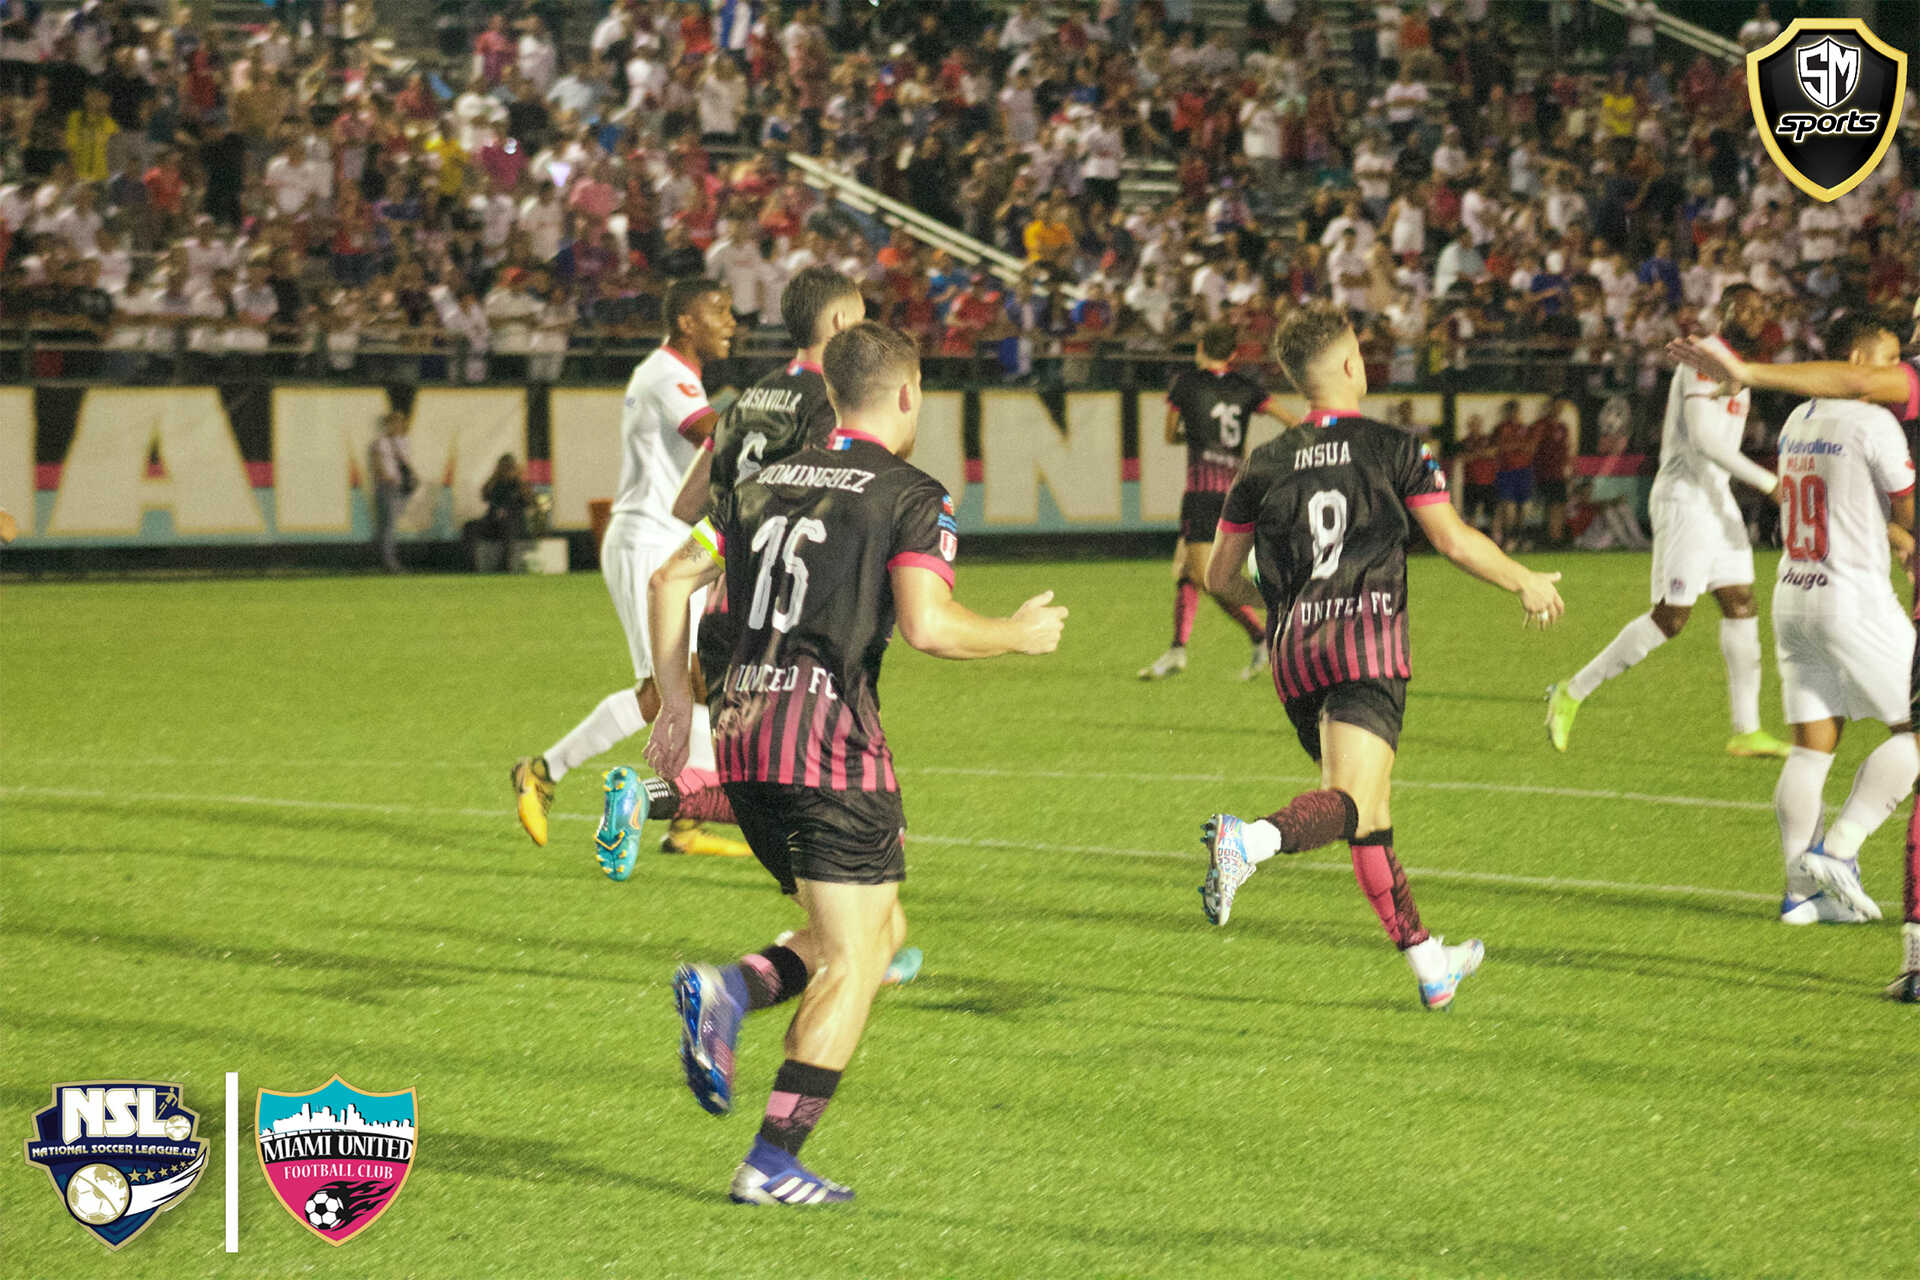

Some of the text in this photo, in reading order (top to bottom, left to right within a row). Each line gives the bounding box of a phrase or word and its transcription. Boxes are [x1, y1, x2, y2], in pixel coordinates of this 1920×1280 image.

[1294, 441, 1351, 471] INSUA
[757, 464, 876, 493] DOMINGUEZ
[1781, 474, 1829, 562] 29
[1782, 568, 1828, 590] hugo
[1371, 591, 1393, 616] FC
[808, 666, 838, 700] FC
